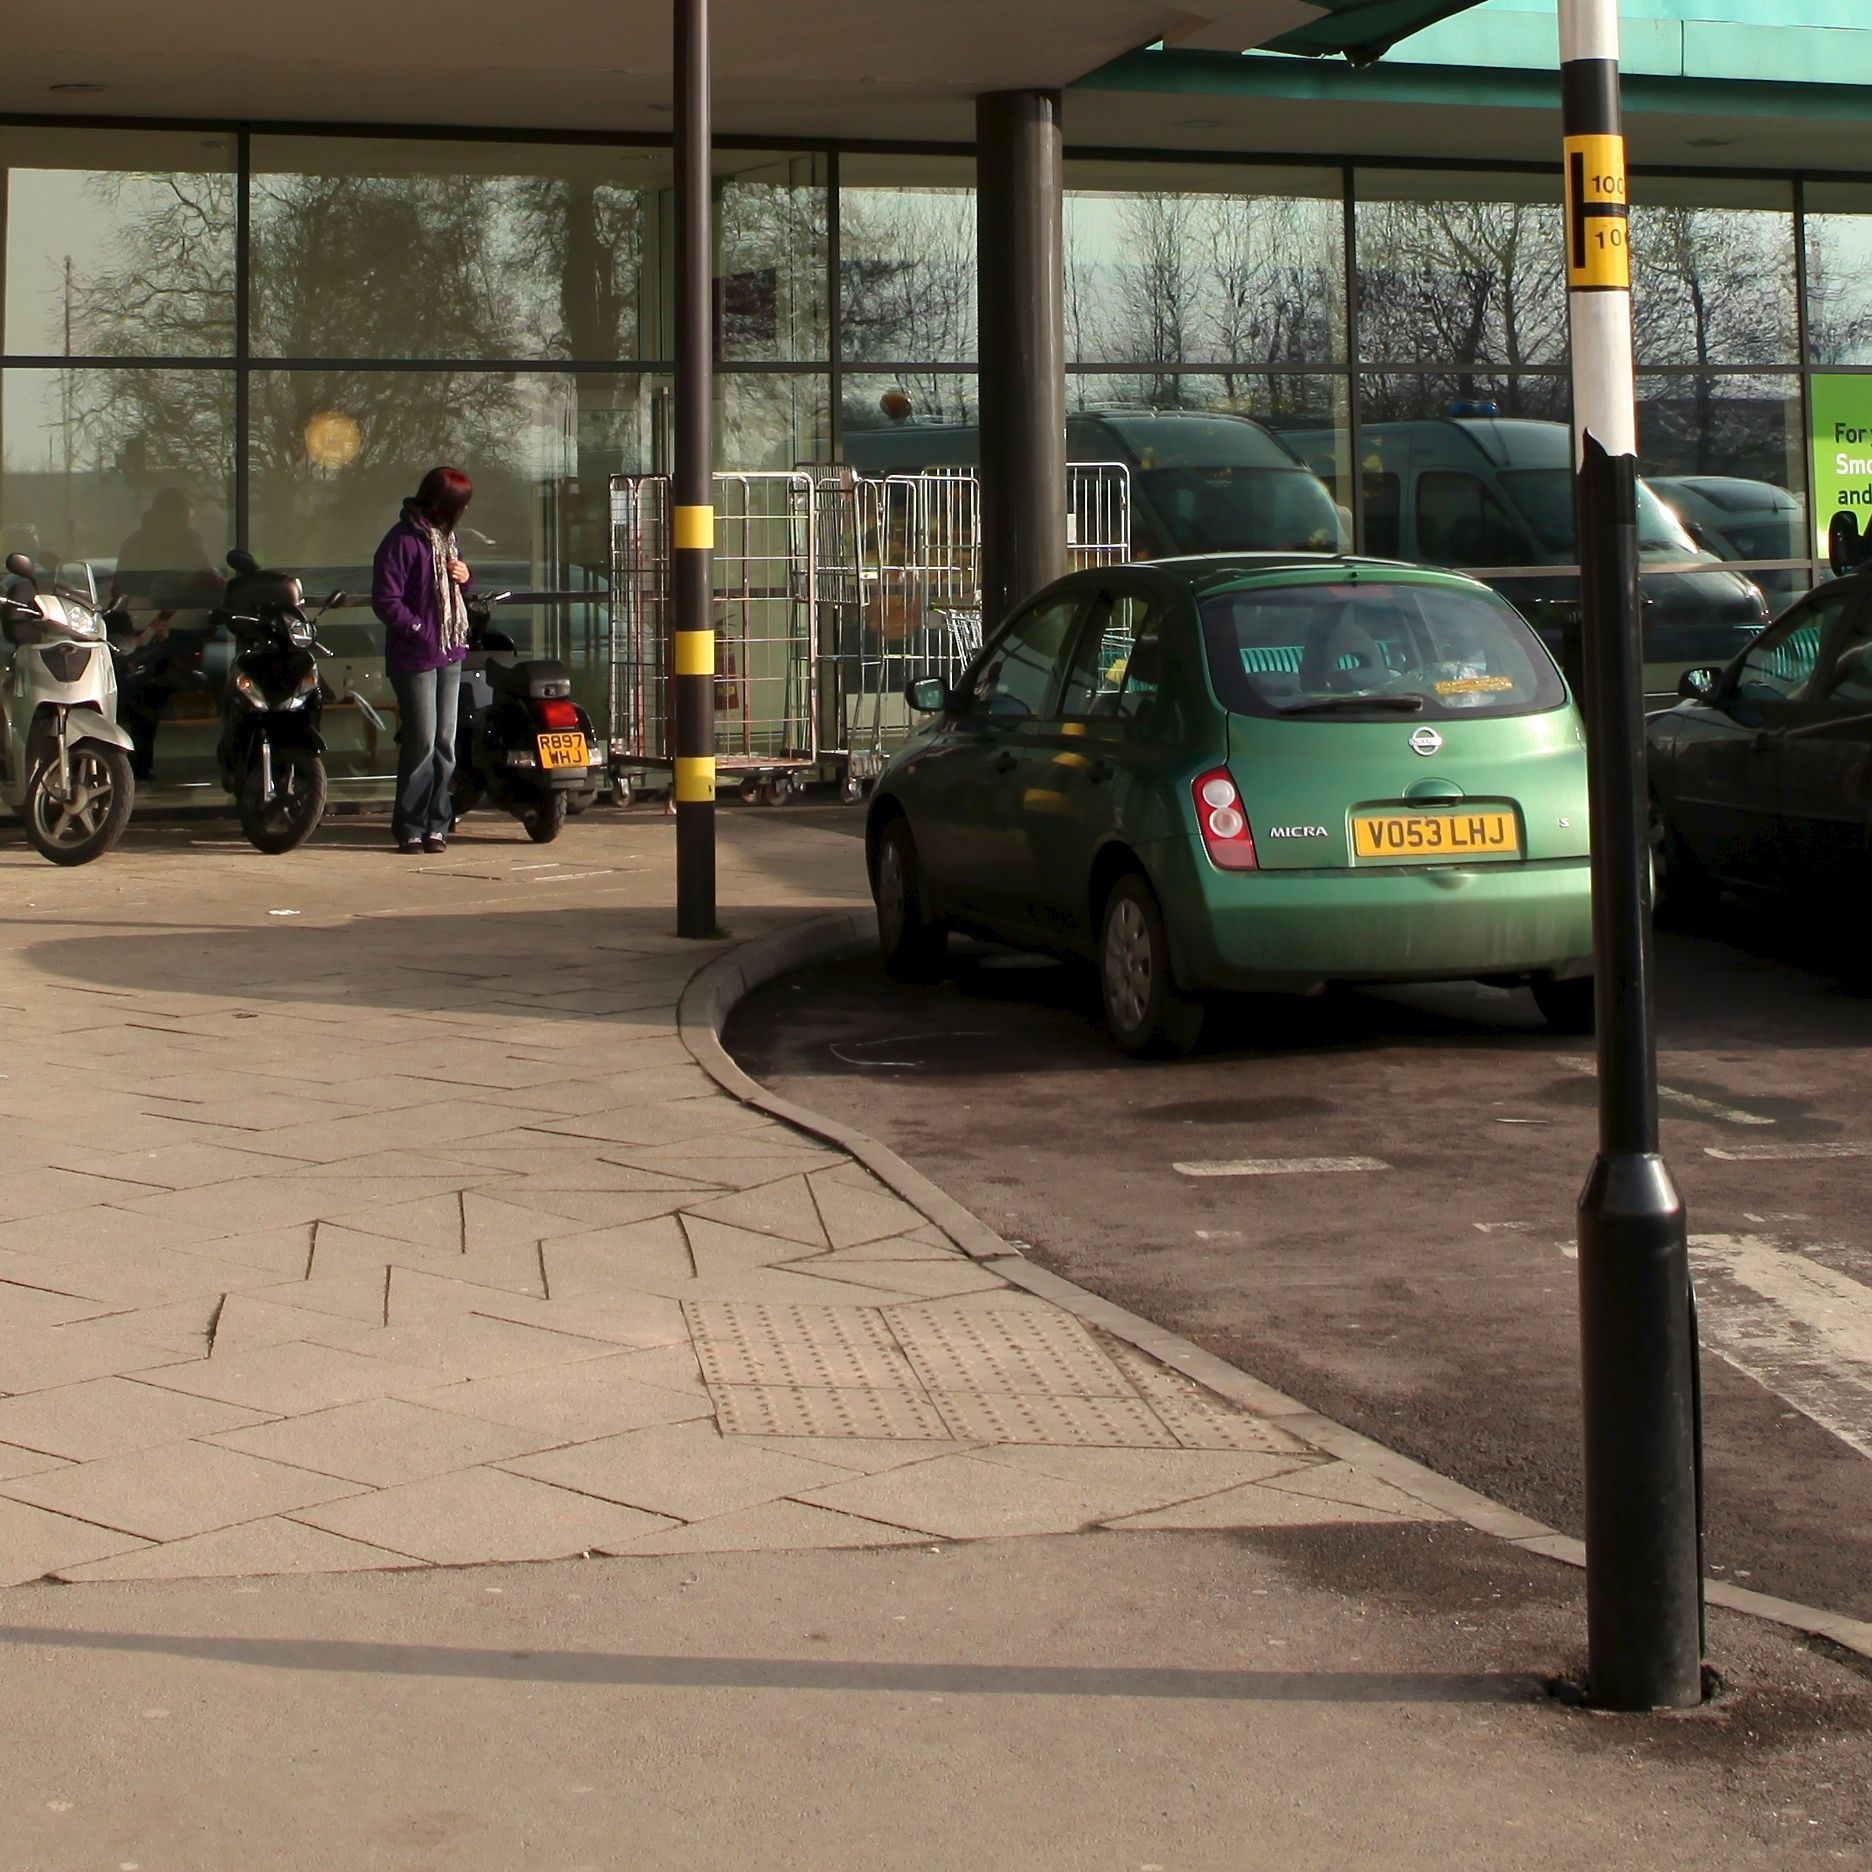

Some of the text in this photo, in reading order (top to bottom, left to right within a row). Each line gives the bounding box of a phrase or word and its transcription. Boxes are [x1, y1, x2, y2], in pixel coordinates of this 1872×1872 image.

[1595, 229, 1630, 249] 10
[1835, 422, 1870, 444] For
[1837, 482, 1872, 506] and
[539, 734, 582, 749] R897
[549, 750, 582, 764] WHJ
[1268, 825, 1329, 839] MICRA
[1450, 816, 1505, 846] LHJ
